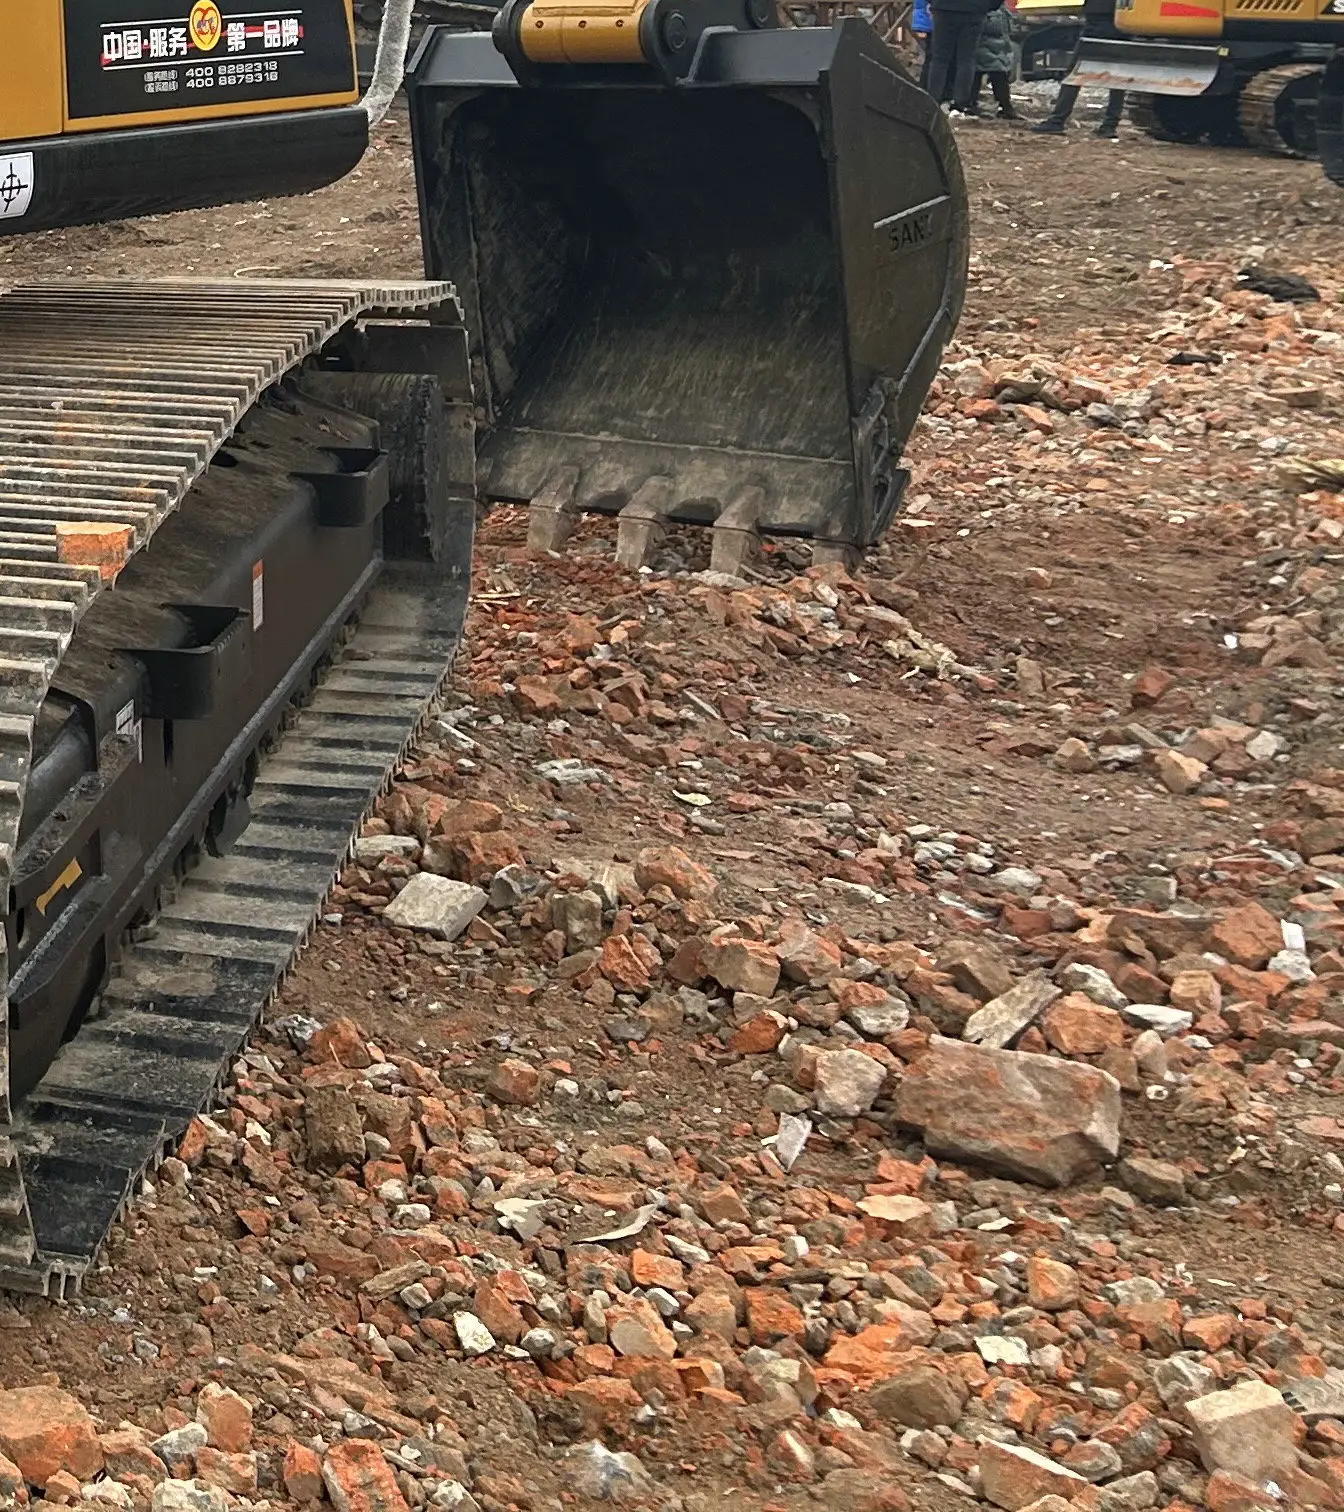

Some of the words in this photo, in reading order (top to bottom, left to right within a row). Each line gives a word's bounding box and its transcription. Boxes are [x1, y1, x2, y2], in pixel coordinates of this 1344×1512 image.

[226, 18, 300, 53] 第一品牌
[185, 66, 214, 78] 400
[185, 78, 215, 89] 400
